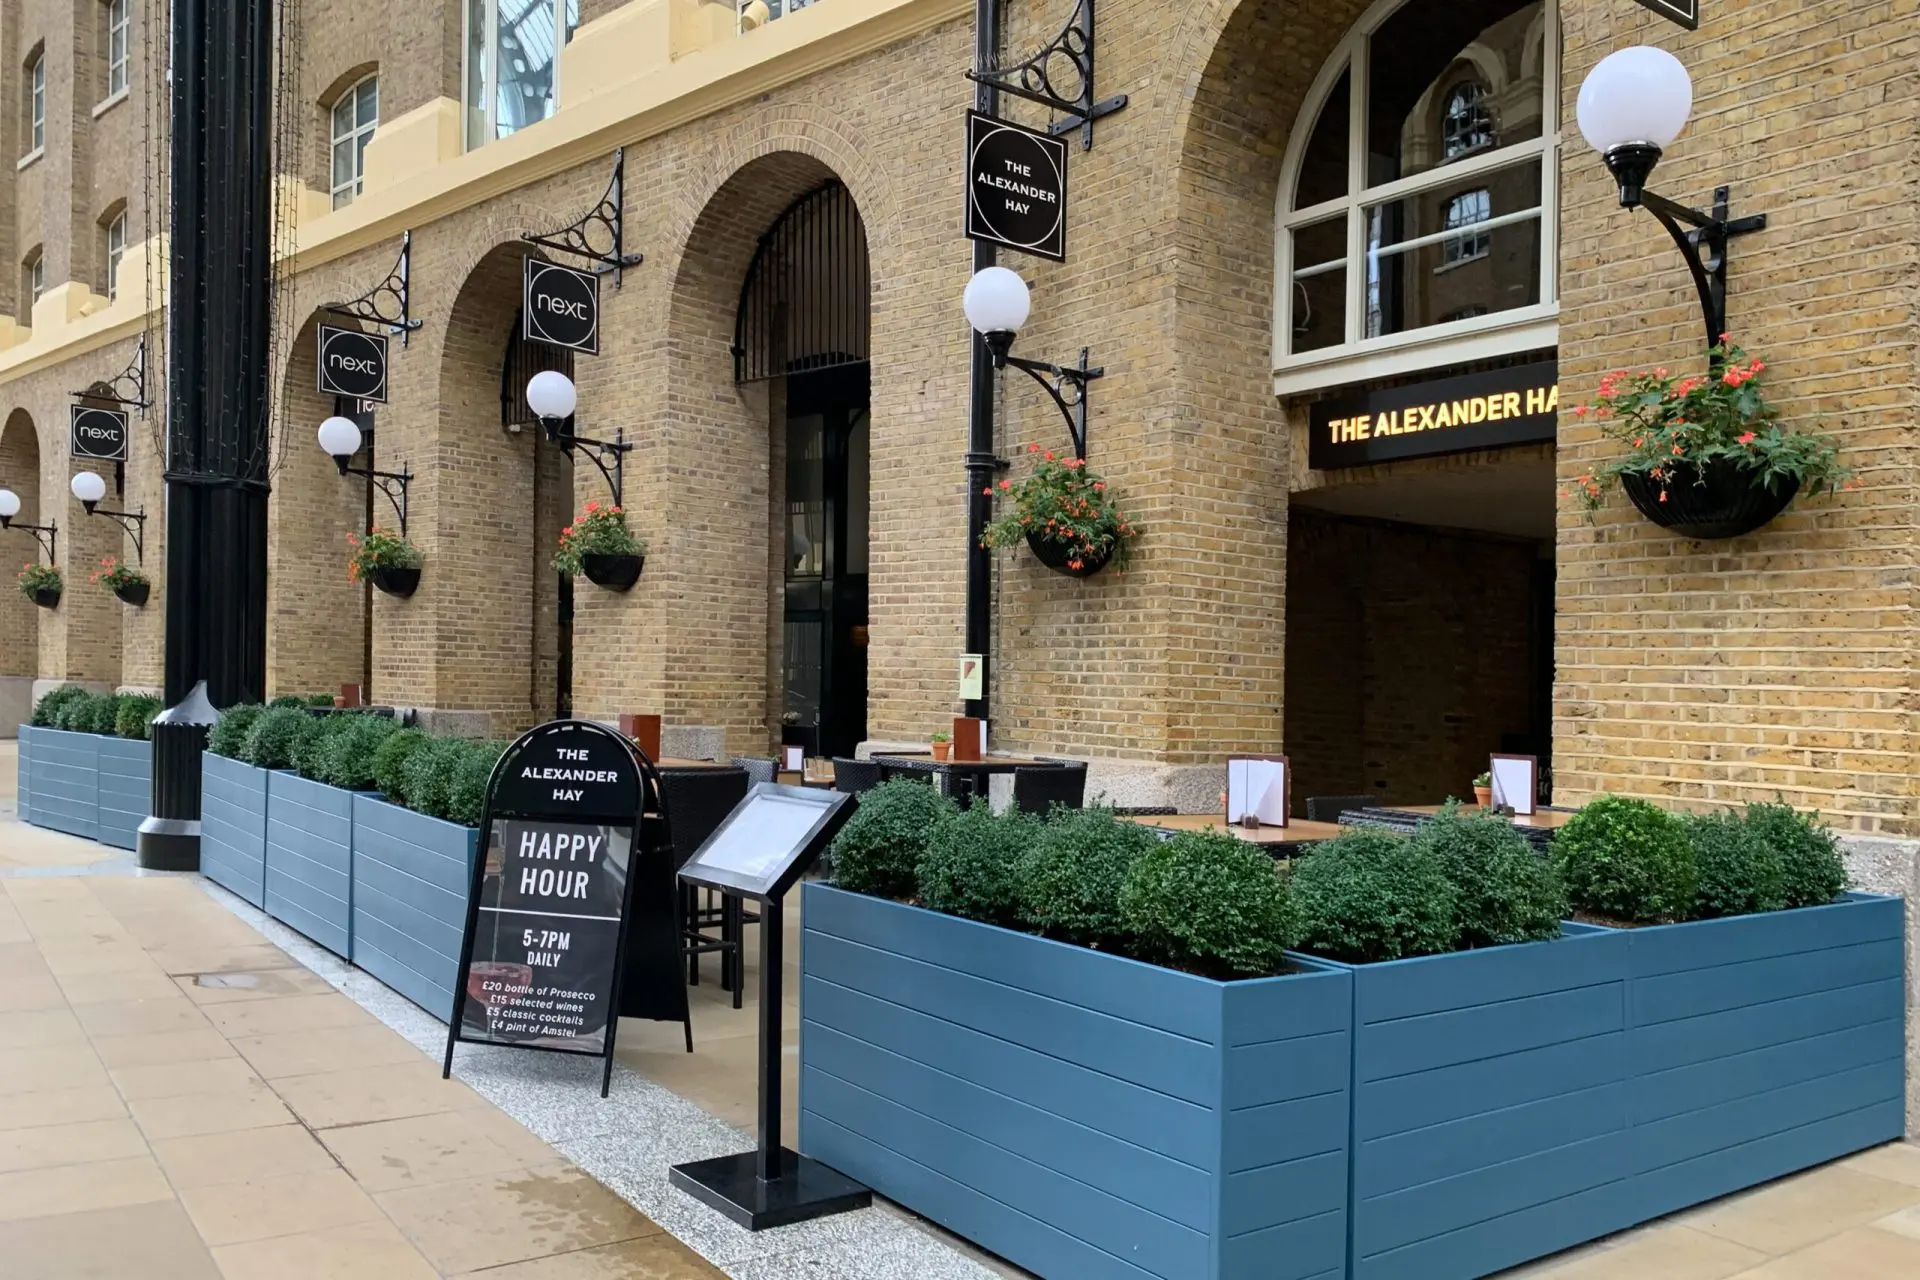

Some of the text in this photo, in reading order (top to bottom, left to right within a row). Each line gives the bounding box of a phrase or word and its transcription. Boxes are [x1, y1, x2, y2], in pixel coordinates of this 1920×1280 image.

[1004, 159, 1031, 177] THE
[977, 171, 1056, 204] ALEXANDER
[1005, 198, 1030, 215] HAY
[538, 293, 587, 320] next
[330, 354, 376, 375] next
[1328, 415, 1371, 444] THE
[1374, 392, 1520, 437] ALEXANDER
[80, 426, 119, 441] next
[557, 748, 589, 761] THE
[521, 766, 618, 783] ALEXANDER
[552, 788, 584, 801] HAY
[519, 831, 601, 862] HAPPY
[520, 868, 589, 898] HOUR
[523, 929, 570, 950] 5-7PM
[527, 951, 561, 967] DAILY
[482, 981, 596, 1001] £20 bottle of Prosecco
[490, 994, 584, 1013] £15 selected wines
[486, 1006, 584, 1026] £5 classic cocktails
[491, 1020, 576, 1038] £4 pint of Amstel
